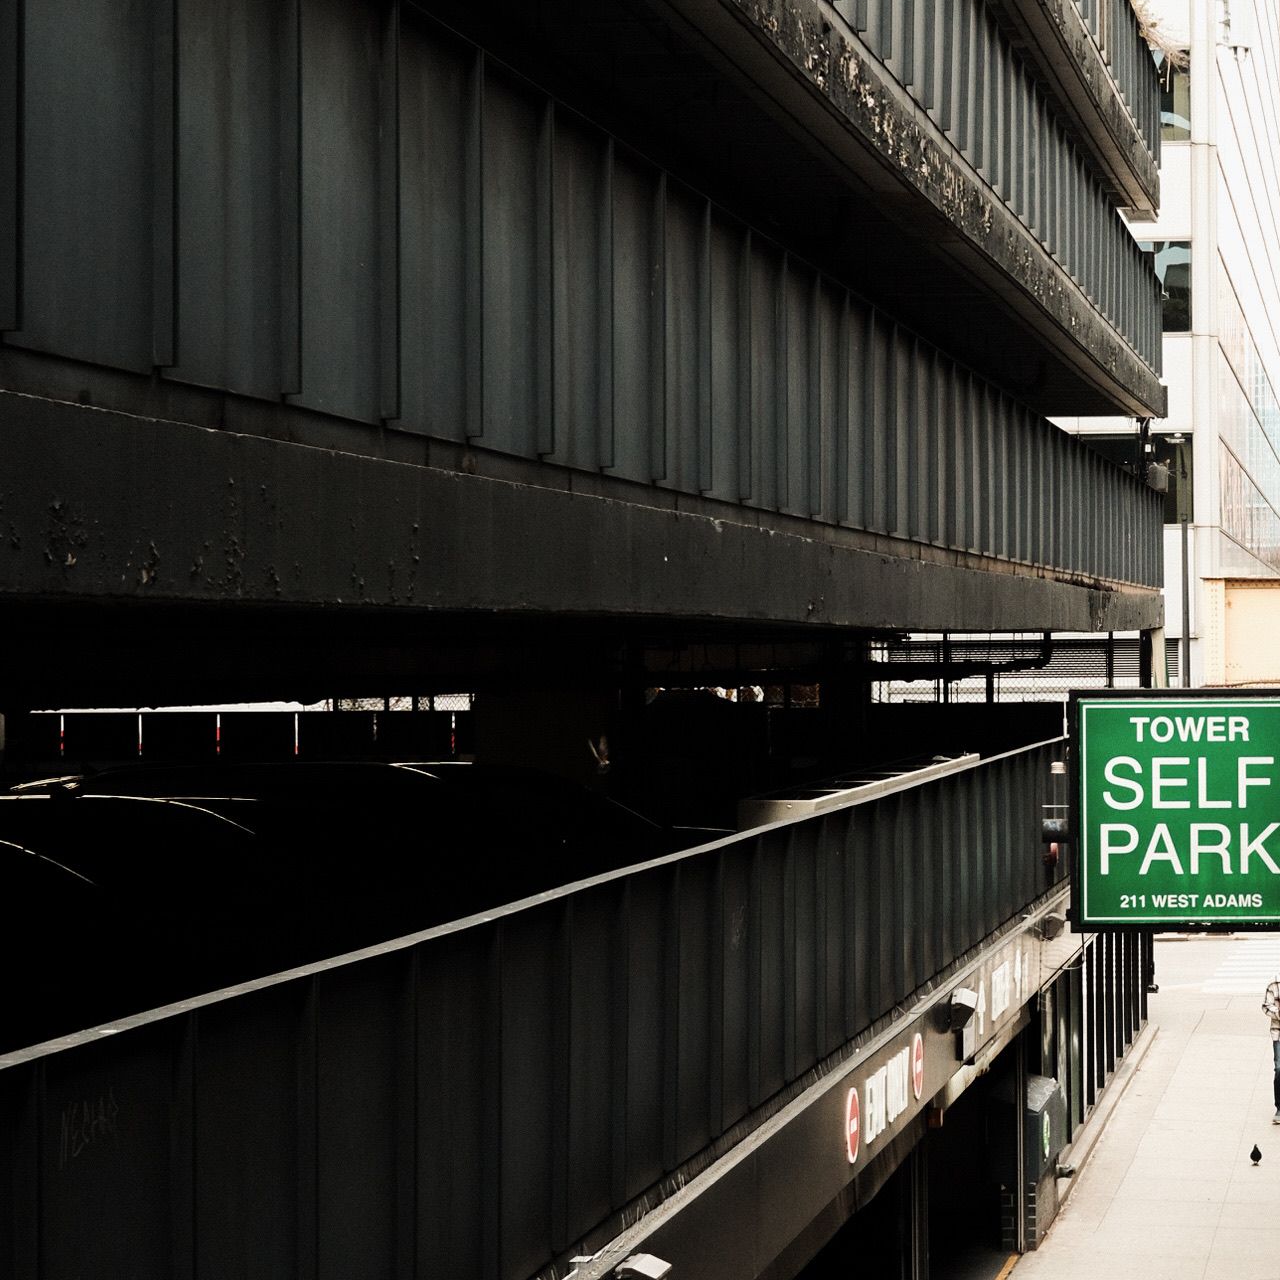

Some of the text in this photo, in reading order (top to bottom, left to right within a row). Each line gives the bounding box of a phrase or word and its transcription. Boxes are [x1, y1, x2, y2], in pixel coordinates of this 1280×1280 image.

[1129, 716, 1250, 743] TOWER
[1102, 755, 1275, 811] SELF
[1120, 894, 1263, 908] 211 WEST ADAMS
